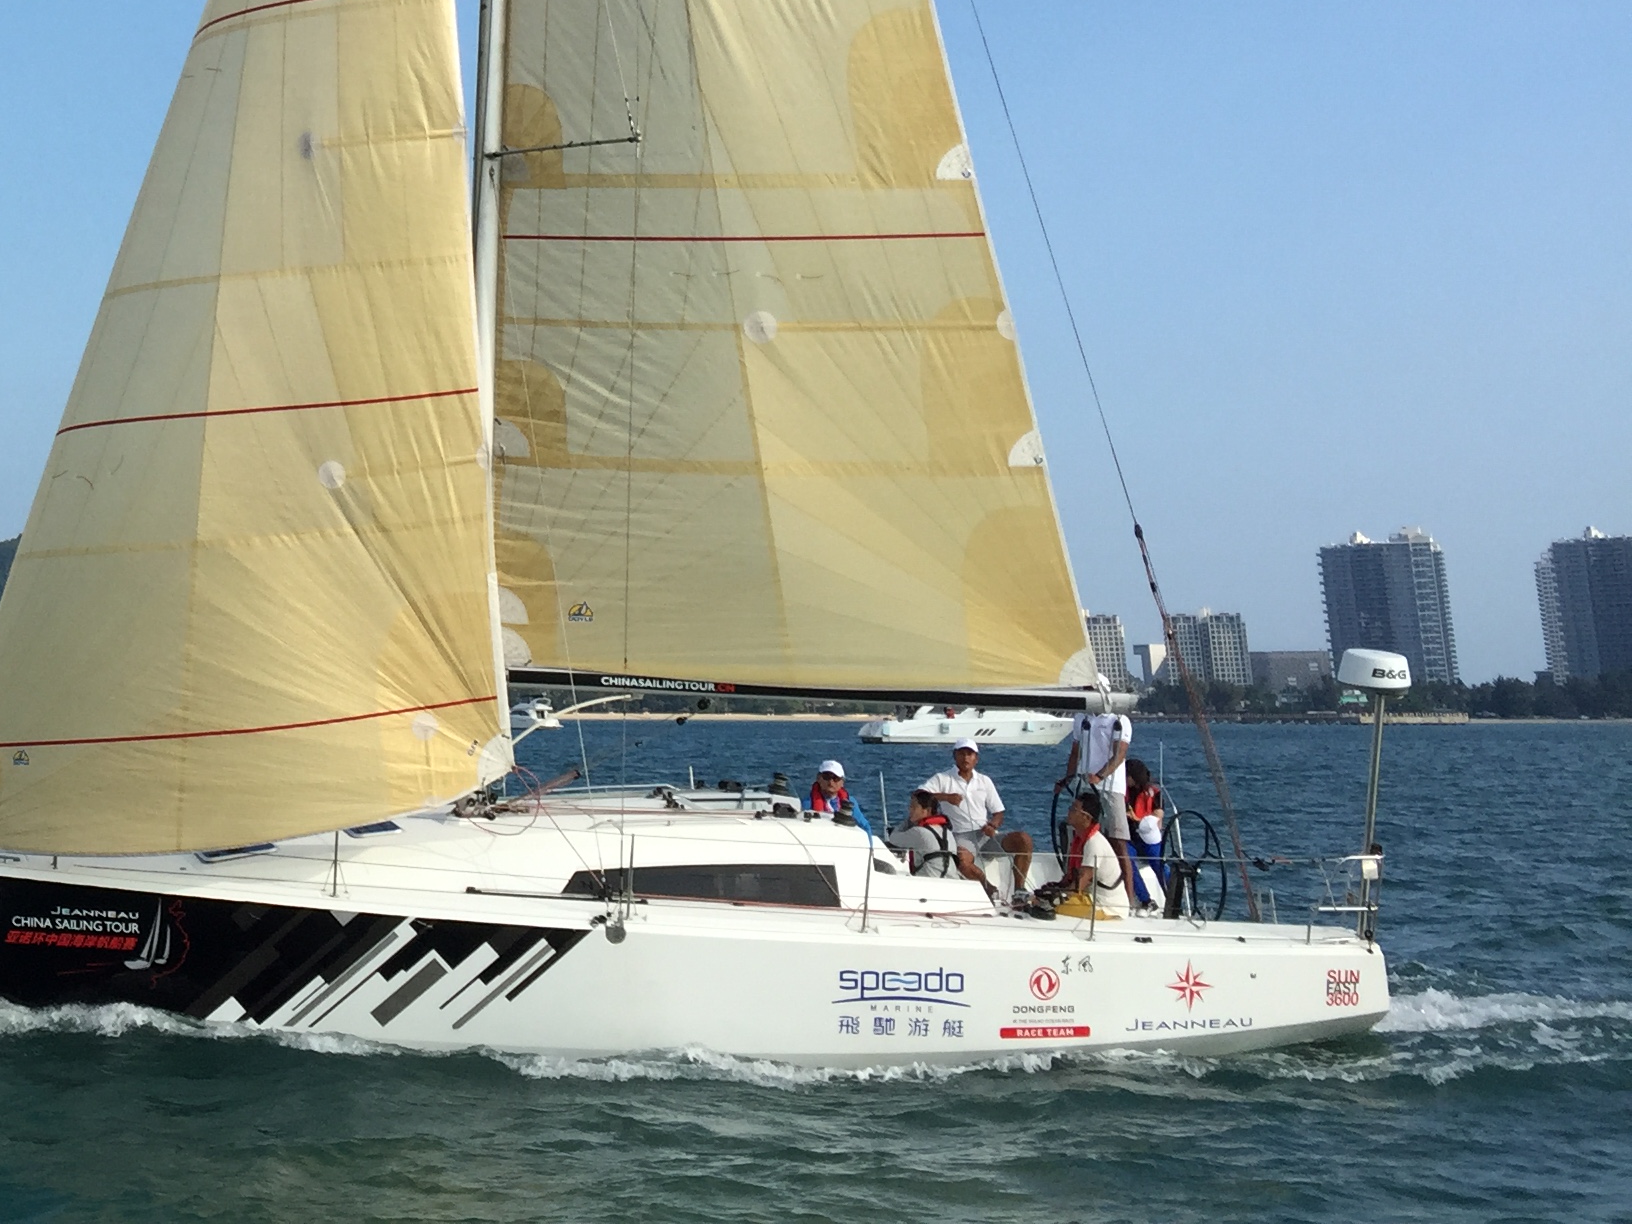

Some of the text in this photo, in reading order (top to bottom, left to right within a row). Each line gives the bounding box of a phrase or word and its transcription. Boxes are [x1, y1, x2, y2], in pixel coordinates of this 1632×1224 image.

[1371, 667, 1407, 680] B&G
[50, 906, 140, 920] JEANNEAU
[11, 915, 140, 934] CHINA SAILING TOUR
[1326, 969, 1360, 984] SUN
[1325, 991, 1359, 1007] 3600
[870, 1004, 934, 1014] MARINE
[1012, 1005, 1075, 1014] DONGFENG
[838, 1015, 965, 1038] 飛馳游艇
[1016, 1027, 1075, 1037] RACE TEAM
[1125, 1018, 1253, 1032] JEANNEAU
